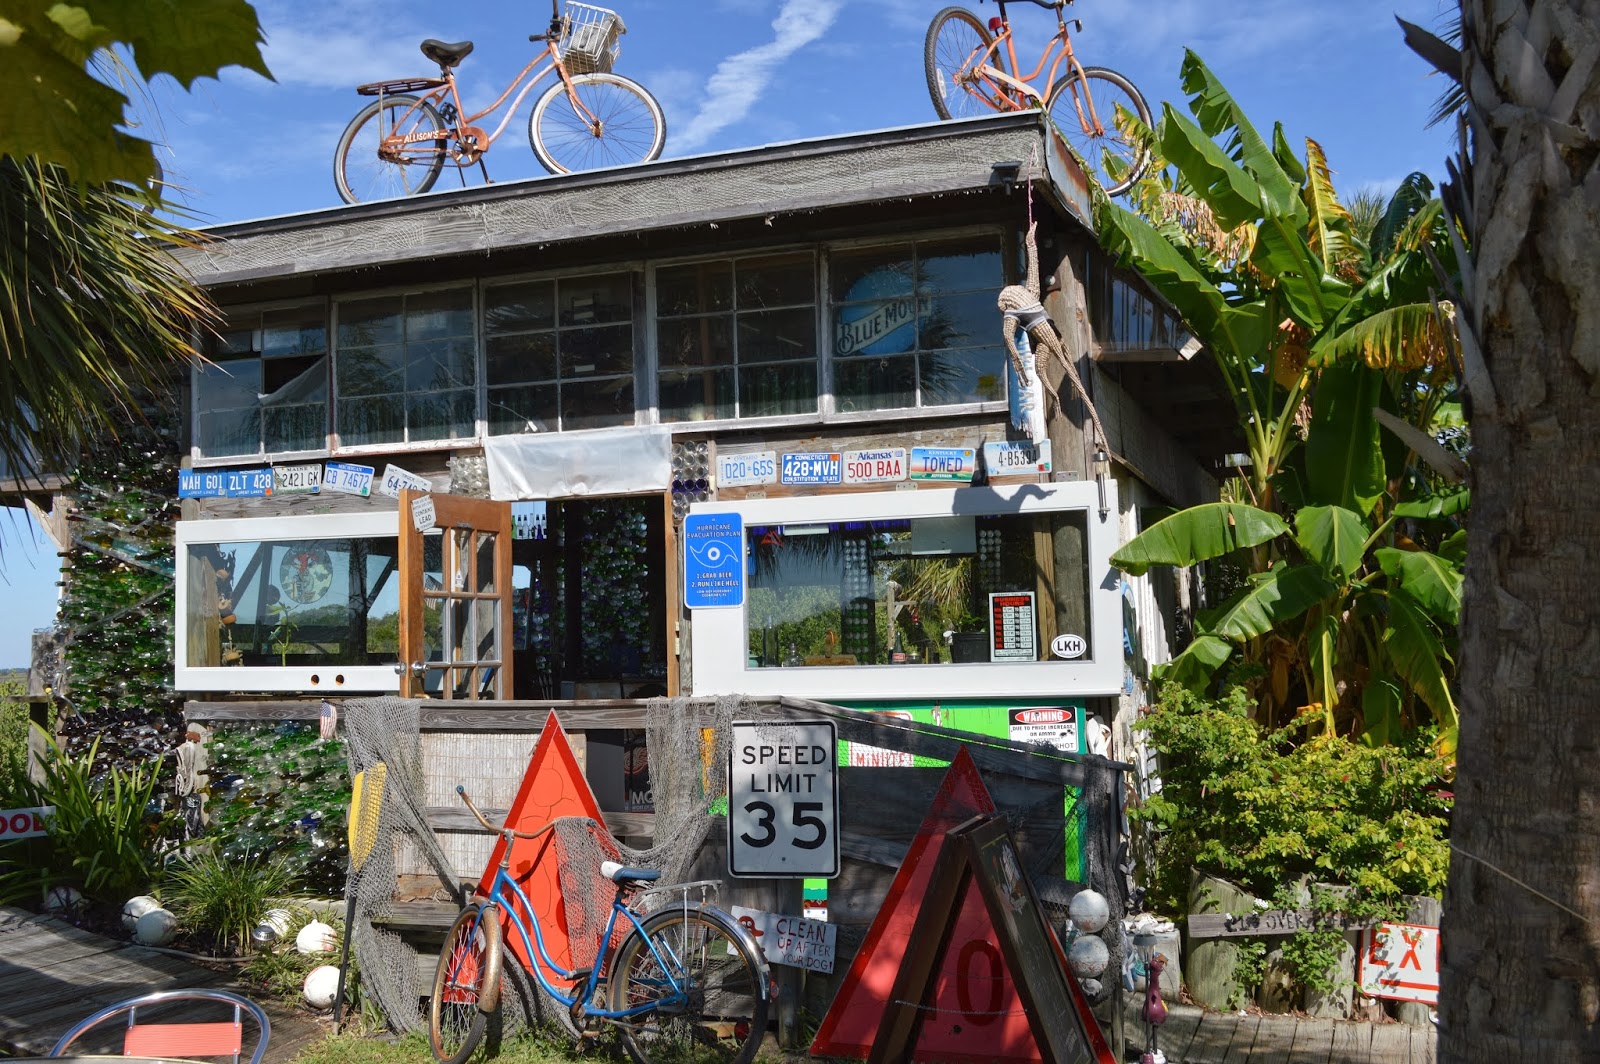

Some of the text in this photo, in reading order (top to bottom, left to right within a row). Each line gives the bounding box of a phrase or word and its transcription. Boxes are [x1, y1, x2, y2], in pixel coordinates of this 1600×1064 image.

[404, 130, 439, 143] ALLISON'S
[838, 315, 882, 354] BLUE
[857, 451, 892, 461] Arkansas
[922, 456, 963, 472] TOWED
[337, 464, 363, 472] MICHIGAN
[848, 459, 901, 479] 500 BAA
[182, 475, 223, 491] WAH 601
[229, 474, 271, 491] ZLT 428
[282, 471, 319, 488] 2421 GK
[326, 469, 370, 488] CB 74672
[419, 514, 432, 525] LEAD
[1057, 640, 1081, 652] LKH
[1023, 711, 1064, 722] WARNING
[741, 745, 827, 765] SPEED
[751, 773, 817, 793] LIMIT
[740, 801, 828, 850] 35
[776, 918, 827, 943] CLEAN
[777, 937, 831, 958] UP AFTER
[781, 951, 805, 966] YOUR
